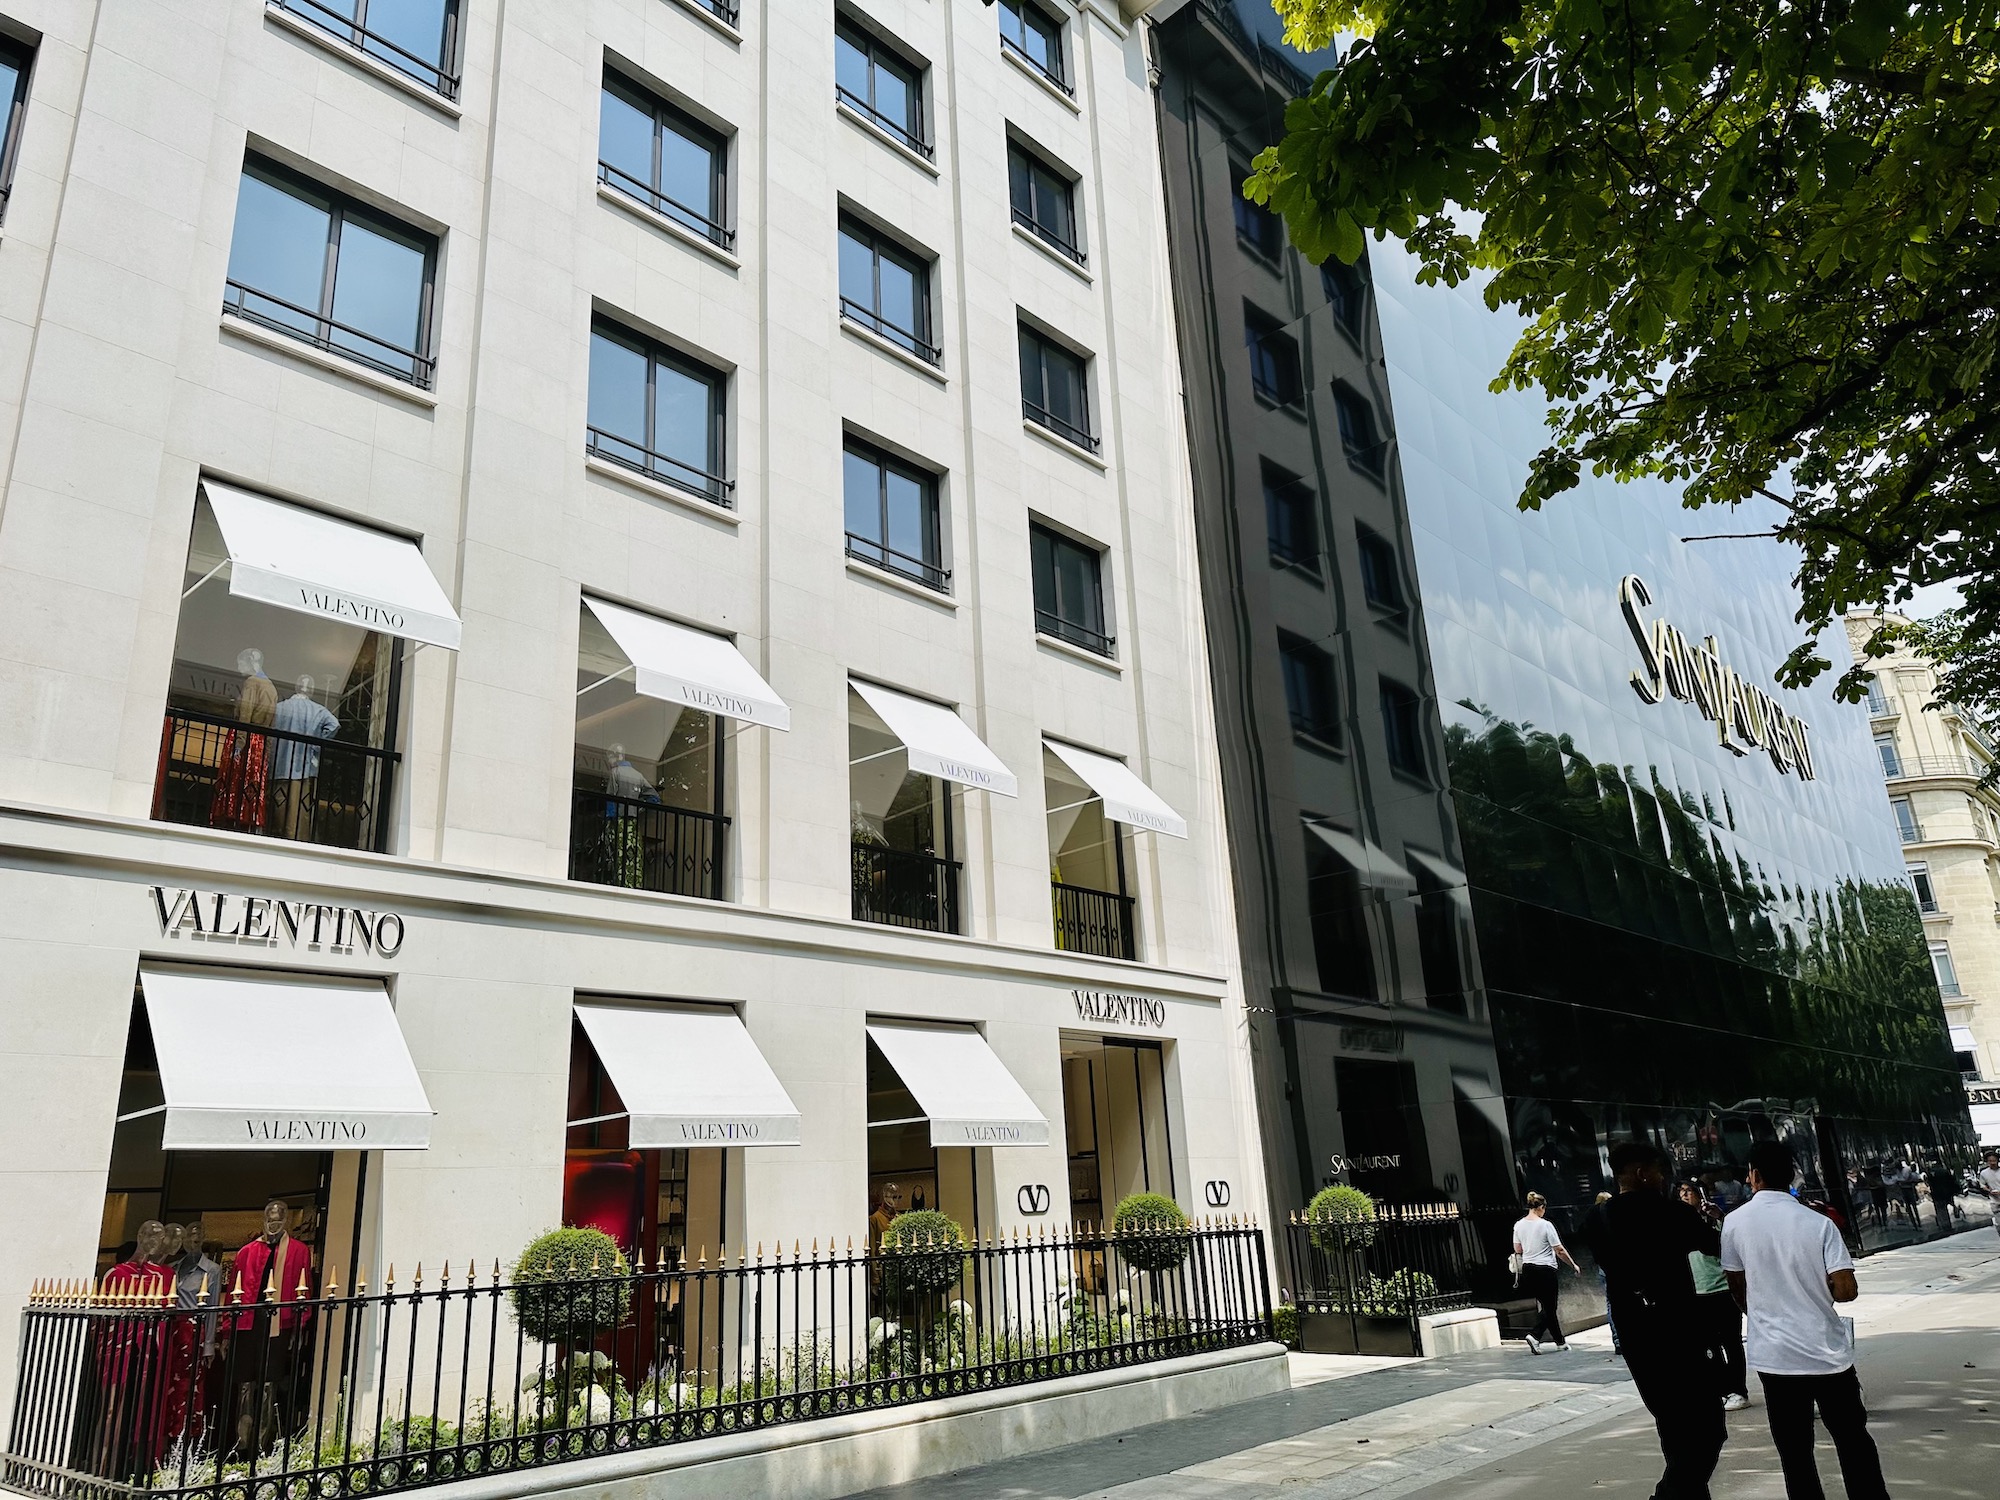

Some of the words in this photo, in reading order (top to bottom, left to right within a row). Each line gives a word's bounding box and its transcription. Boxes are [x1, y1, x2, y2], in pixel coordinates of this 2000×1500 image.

[300, 588, 405, 630] VALENTINO
[681, 685, 753, 717] VALENTINO
[939, 761, 991, 785] VALENTINO
[1127, 809, 1167, 829] VALENTINO
[149, 886, 405, 958] VALENTINO
[1072, 990, 1166, 1028] VALENTINO
[246, 1119, 366, 1142] VALENTINO
[681, 1123, 759, 1141] VALENTINO
[964, 1125, 1020, 1142] VALENTINO
